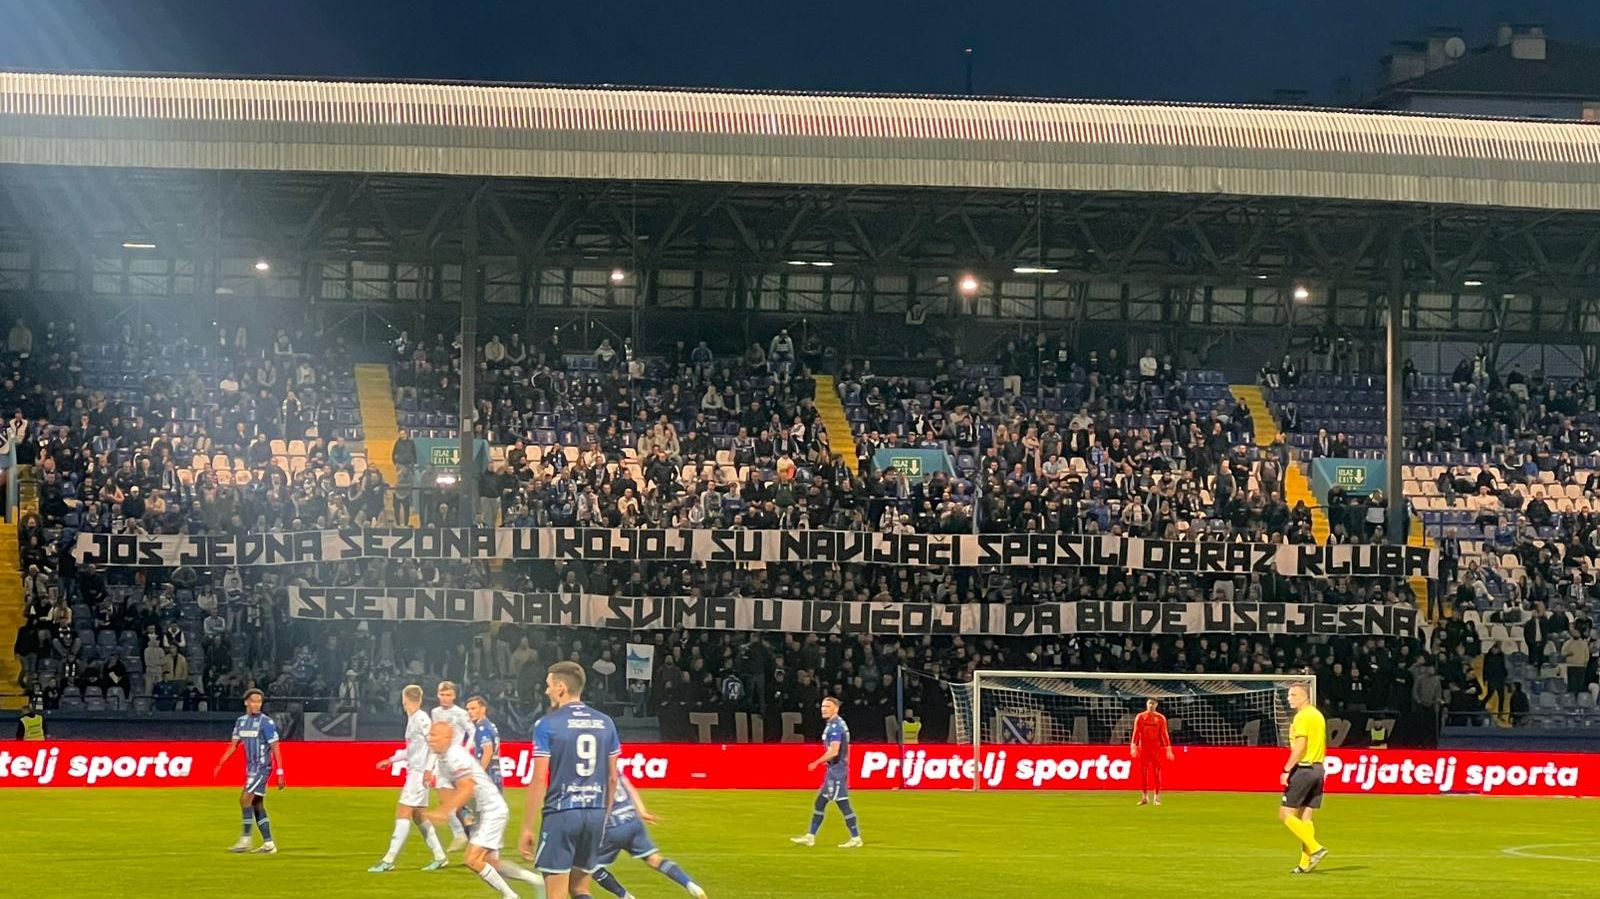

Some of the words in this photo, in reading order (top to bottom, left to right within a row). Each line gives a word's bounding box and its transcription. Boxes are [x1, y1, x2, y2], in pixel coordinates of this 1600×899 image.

[433, 457, 449, 465] EXIT
[1338, 476, 1354, 484] EXIT
[83, 534, 163, 565] JOŠ
[180, 532, 323, 565] JEDNA
[338, 528, 496, 558] SEZONA
[512, 528, 539, 557] U
[555, 529, 693, 559] KOJOJ
[711, 530, 762, 560] SU
[780, 531, 961, 565] NAVIJAČI
[978, 534, 1129, 566] SPASILI
[1143, 539, 1278, 572] OBRAZ
[1297, 545, 1431, 576] KLUBA
[298, 588, 475, 620] SRETNO
[491, 590, 581, 624] NAM
[605, 596, 736, 630] SVIMA
[753, 599, 783, 630] U
[802, 600, 961, 634] IDUĆOJ
[980, 602, 990, 633] I
[1005, 602, 1061, 634] DA
[1076, 601, 1188, 632] BUDE
[1204, 602, 1418, 638] USPJEŠNA
[68, 751, 193, 783] sporta
[575, 734, 597, 777] 9
[860, 750, 1007, 786] Prijatelj
[1015, 754, 1132, 786] sporta
[1324, 755, 1457, 791] Prijatelj
[1465, 761, 1579, 791] sporta
